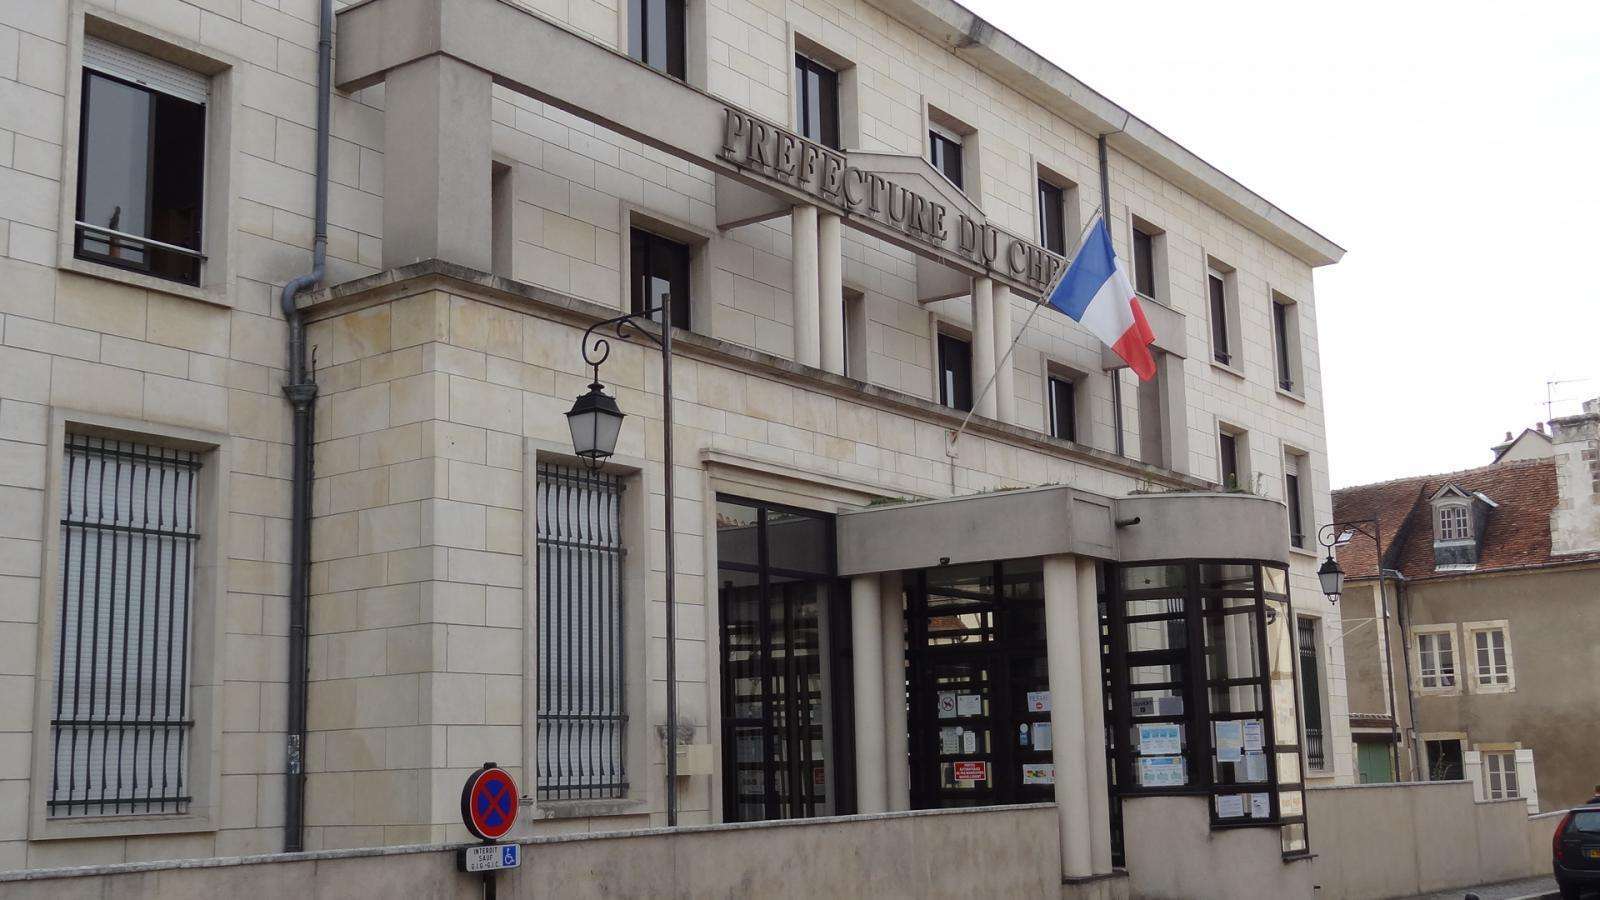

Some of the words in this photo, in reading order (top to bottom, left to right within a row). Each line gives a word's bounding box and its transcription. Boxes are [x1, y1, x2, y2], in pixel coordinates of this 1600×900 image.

[723, 107, 948, 242] PREFECTURE
[959, 214, 1000, 263] DU
[1009, 240, 1060, 286] CHE
[473, 847, 498, 855] INTERDIT
[478, 854, 493, 862] SAUF
